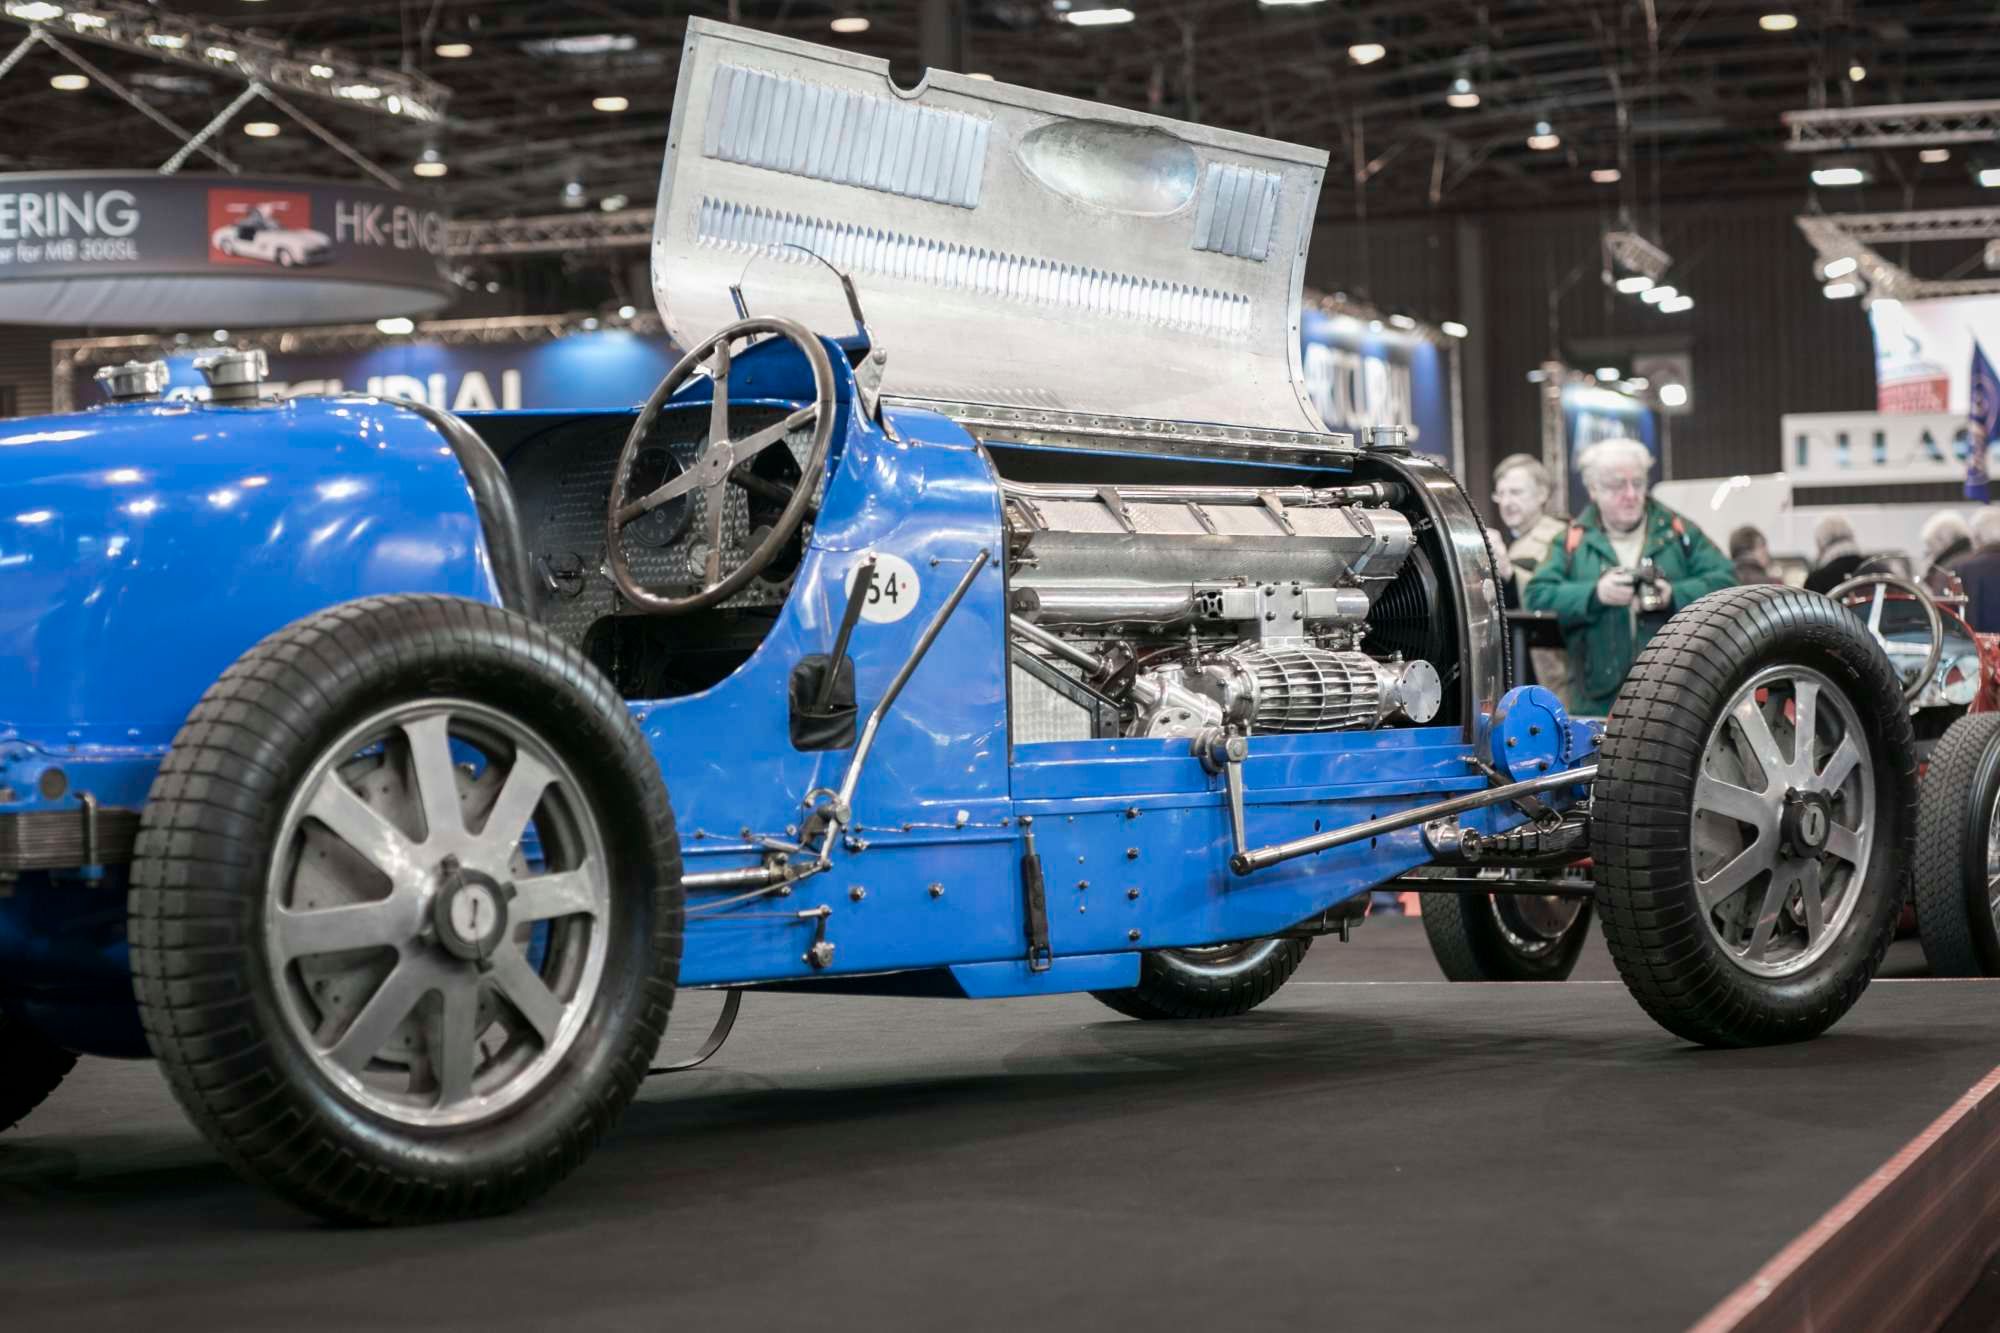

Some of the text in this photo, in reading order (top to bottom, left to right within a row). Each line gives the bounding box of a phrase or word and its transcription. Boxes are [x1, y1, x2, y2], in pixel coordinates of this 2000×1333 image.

[45, 239, 77, 261] MB
[80, 238, 138, 260] 300SL
[866, 571, 898, 604] 54
